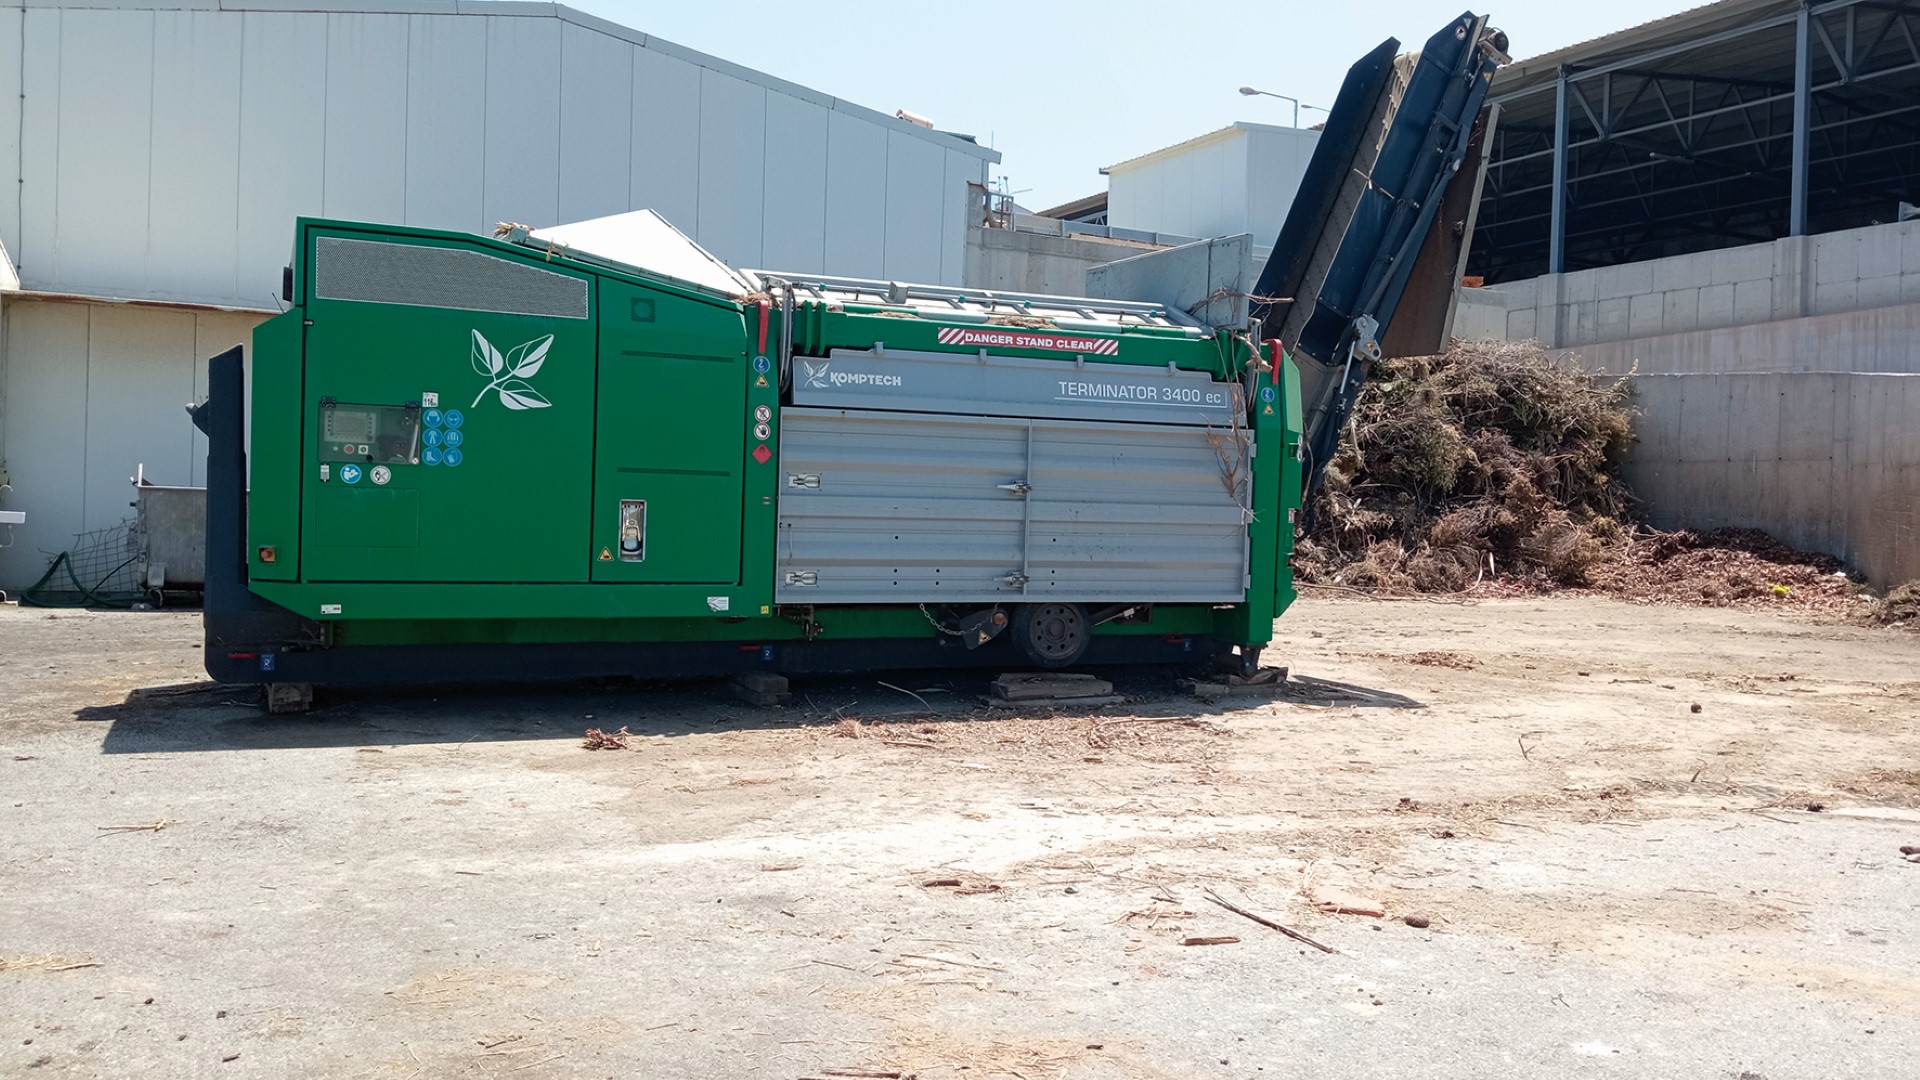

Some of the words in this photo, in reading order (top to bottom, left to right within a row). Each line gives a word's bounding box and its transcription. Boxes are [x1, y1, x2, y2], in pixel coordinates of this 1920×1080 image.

[965, 332, 1013, 345] DANGER
[1016, 337, 1053, 347] STAND
[1056, 340, 1093, 350] CLEAR
[830, 372, 902, 387] KOMPTECH
[1058, 381, 1157, 400] TERMINATOR
[1162, 387, 1200, 403] 3400
[1206, 393, 1221, 404] ec
